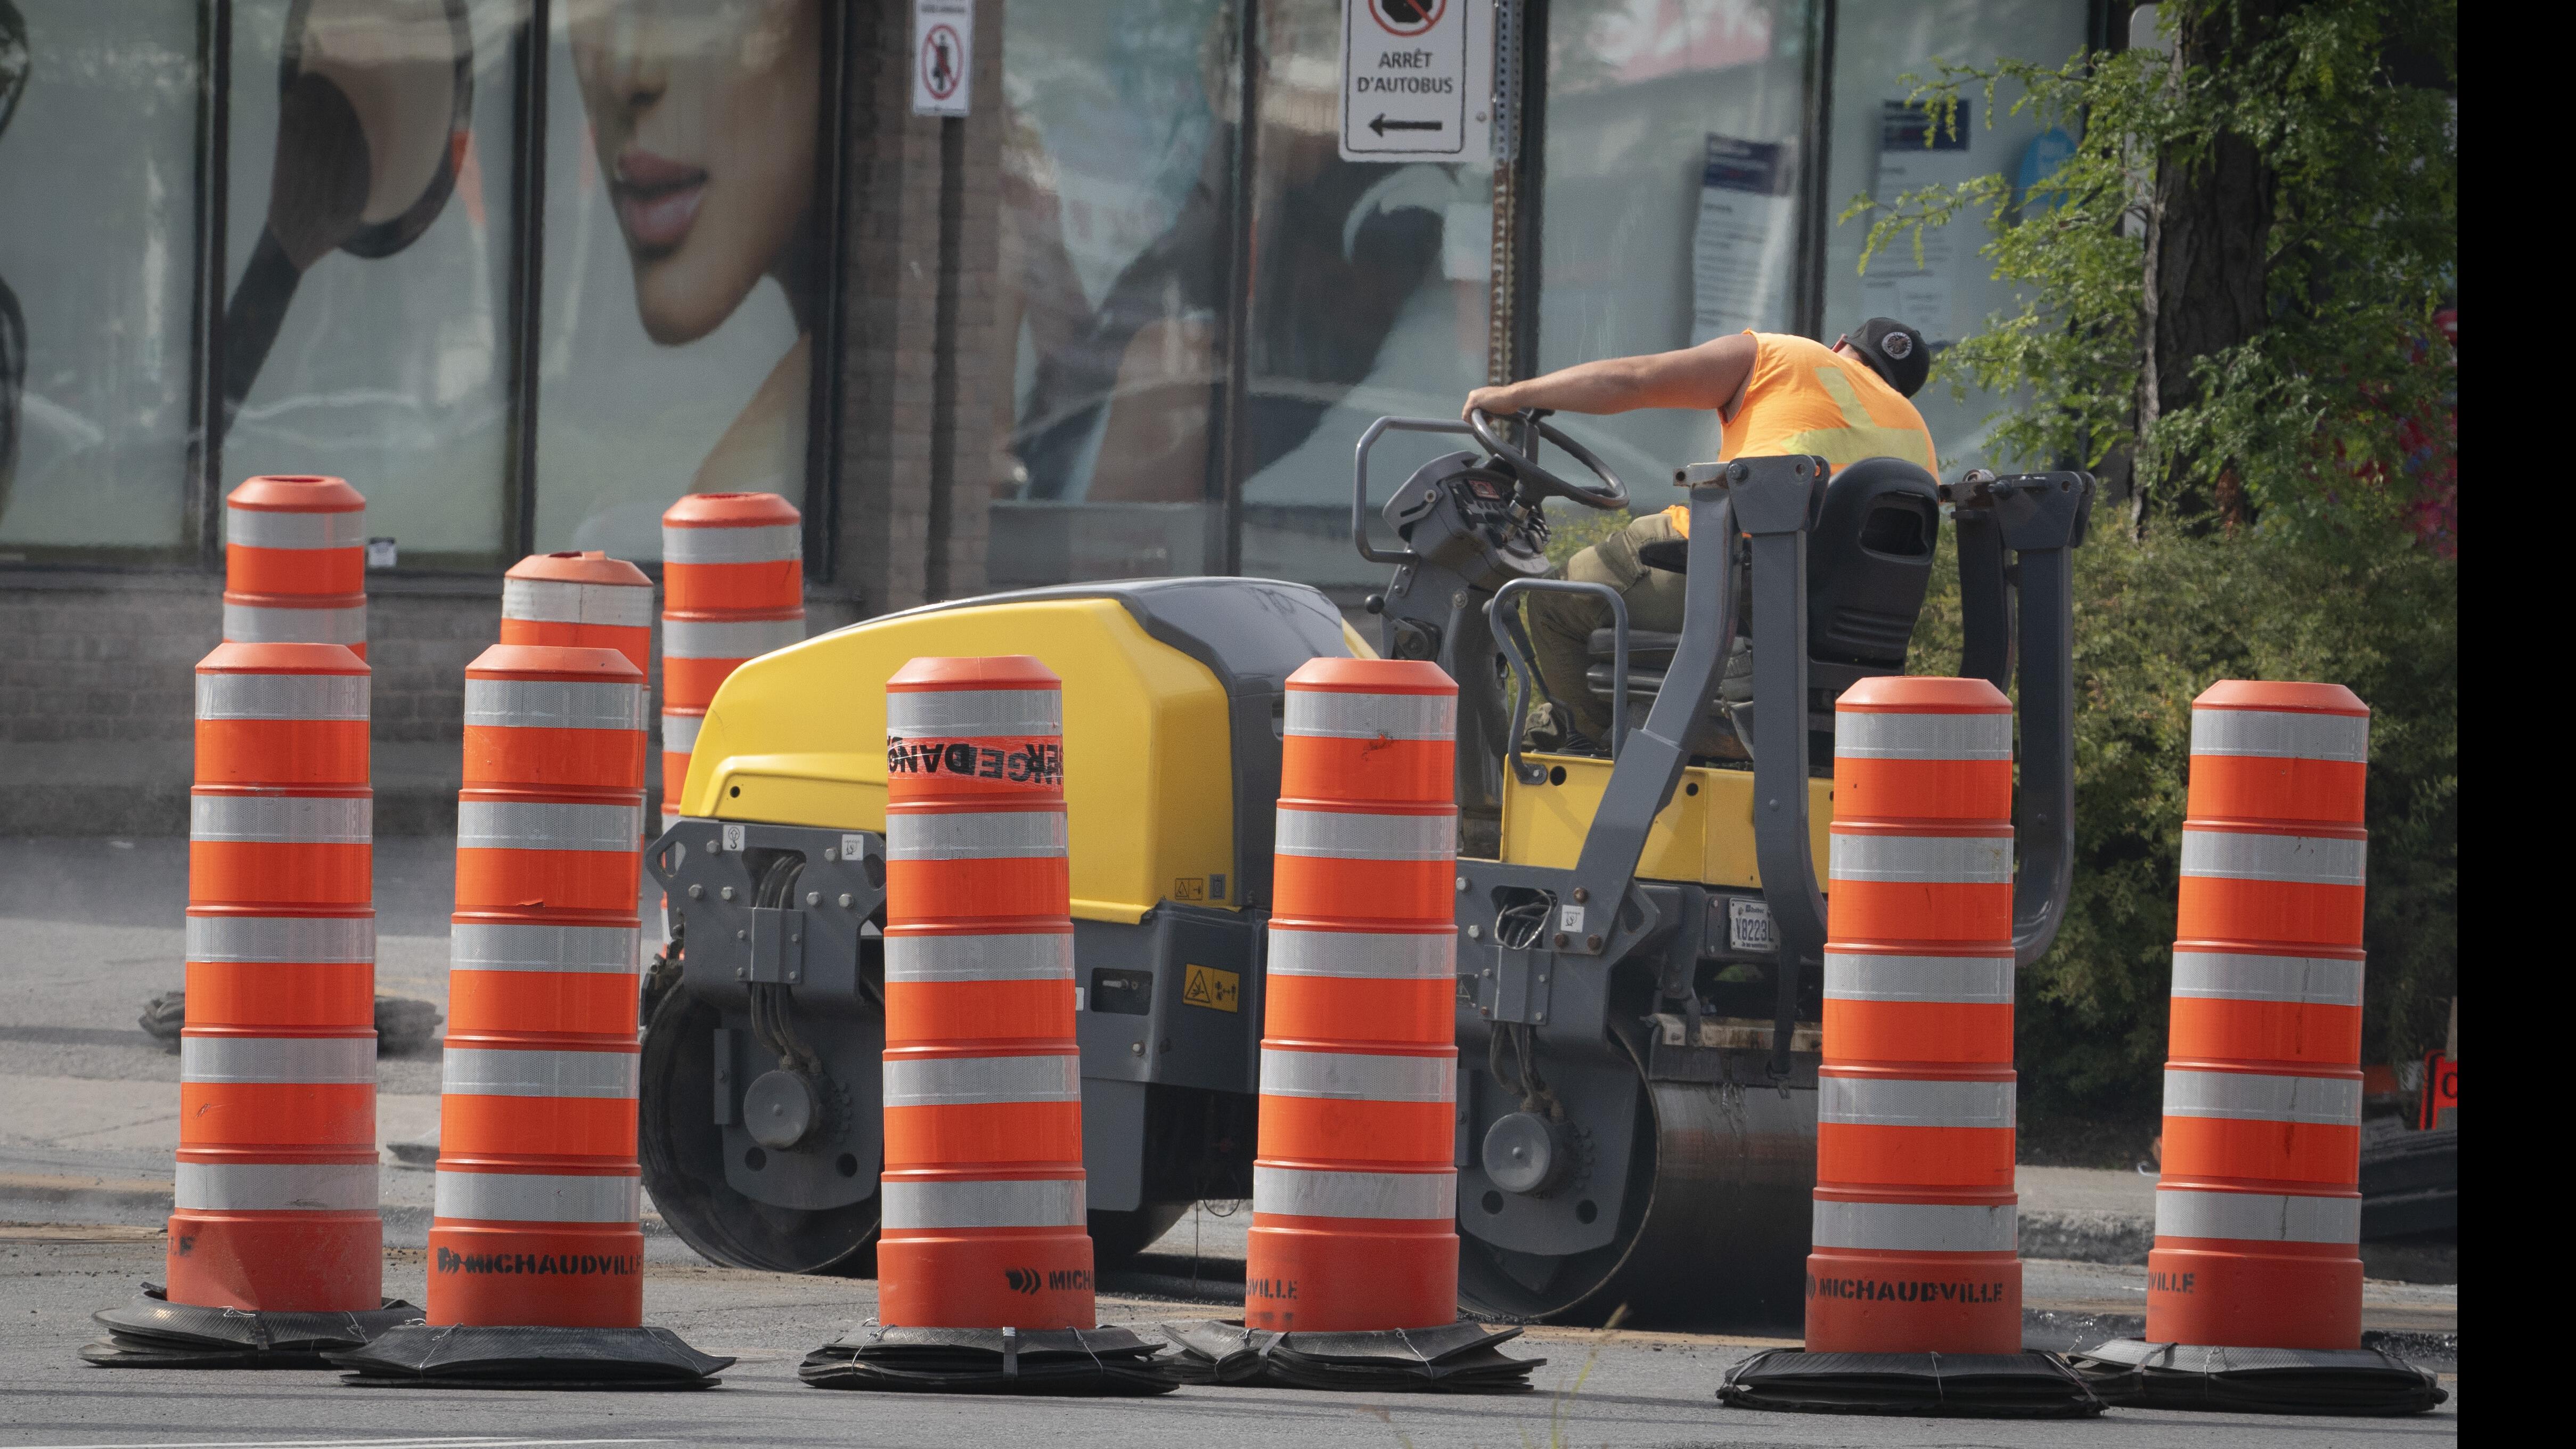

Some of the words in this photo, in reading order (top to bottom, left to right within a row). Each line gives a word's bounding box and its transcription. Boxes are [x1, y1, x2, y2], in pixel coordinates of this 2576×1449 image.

[1378, 47, 1433, 68] ARRÊT
[1357, 76, 1452, 93] D'AUTOBUS
[1819, 1278, 2003, 1303] MICHAUDVILLE
